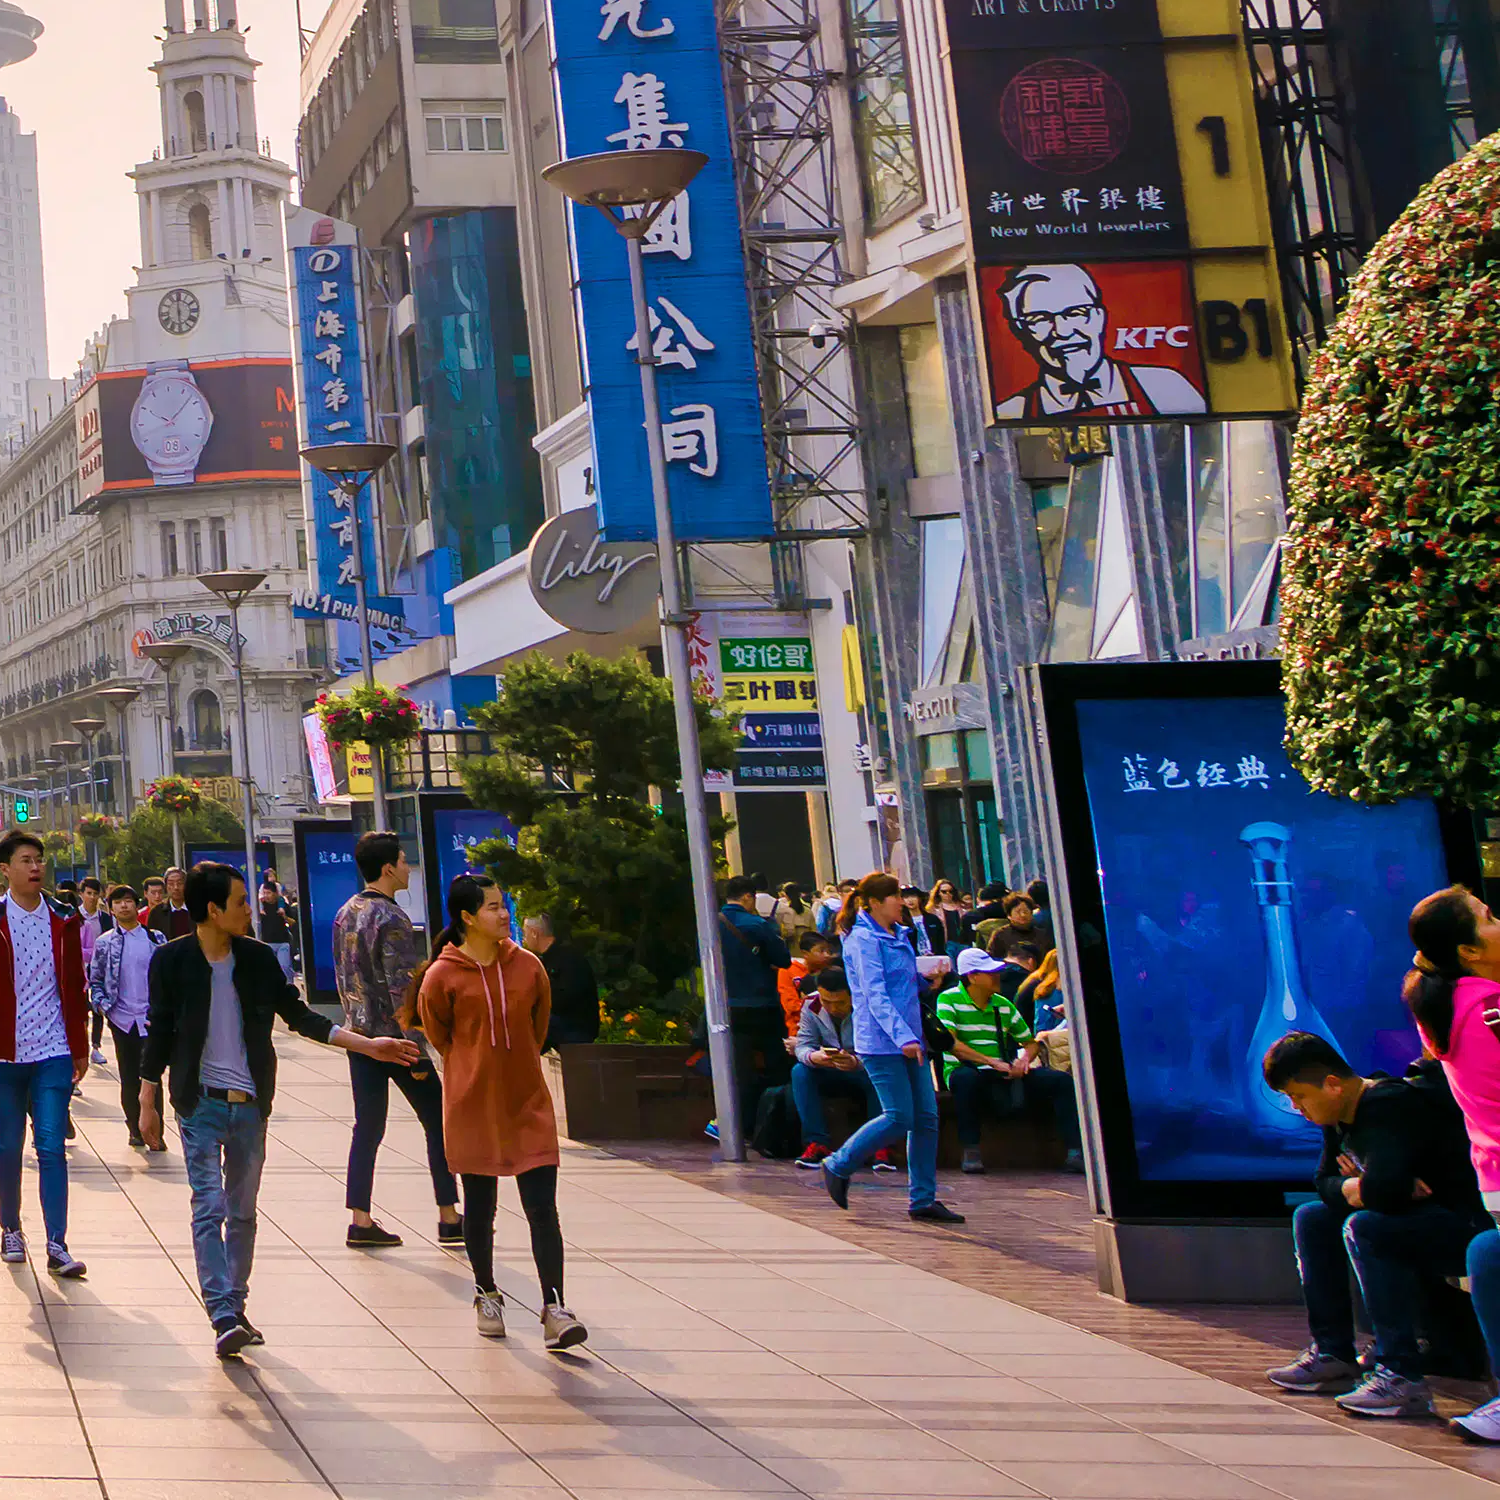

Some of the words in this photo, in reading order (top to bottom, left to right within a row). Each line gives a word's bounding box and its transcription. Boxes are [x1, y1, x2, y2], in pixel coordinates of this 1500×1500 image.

[1195, 116, 1232, 178] 1
[990, 224, 1028, 238] New
[1036, 222, 1088, 236] World
[1114, 325, 1192, 349] KFC
[1203, 298, 1273, 364] B1
[313, 280, 362, 586] 上海市第一商店
[165, 440, 180, 452] 08
[730, 644, 809, 668] 好伦哥
